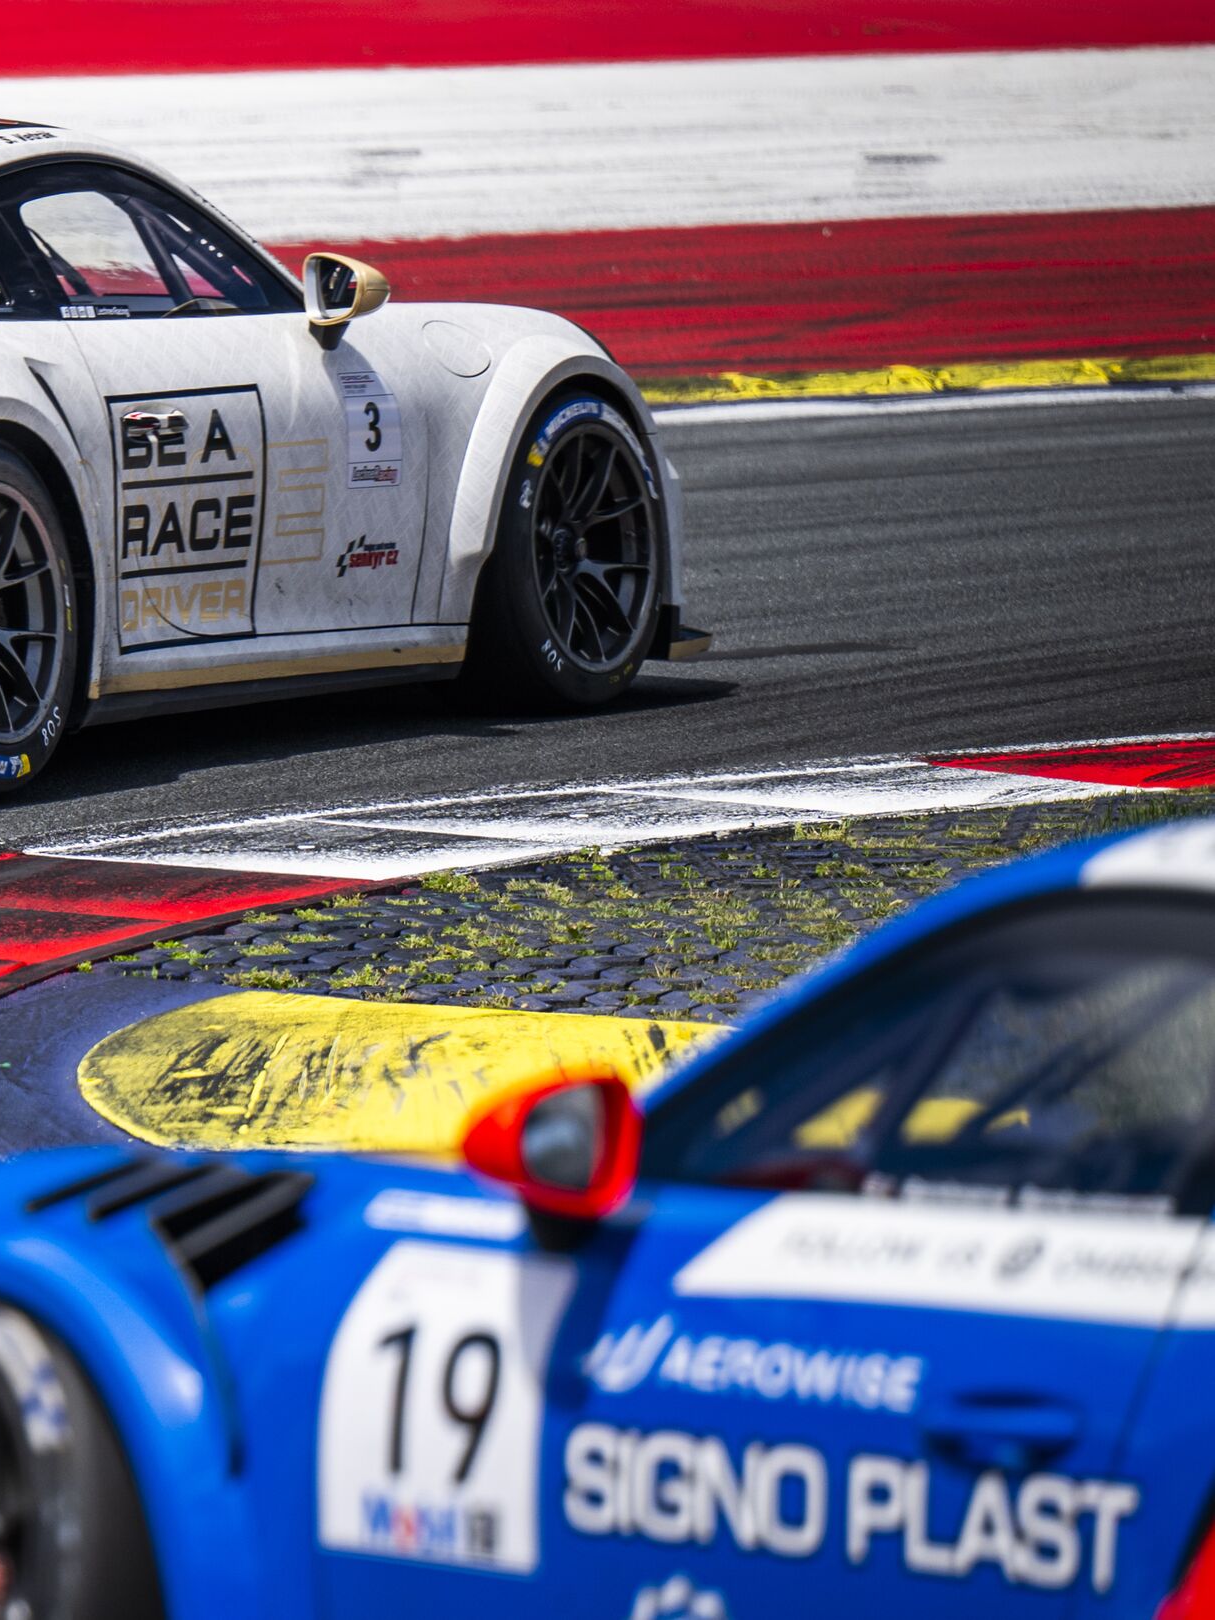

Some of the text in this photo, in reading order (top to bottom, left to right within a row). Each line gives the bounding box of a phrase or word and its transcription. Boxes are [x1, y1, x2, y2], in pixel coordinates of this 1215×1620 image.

[200, 408, 236, 464] A
[363, 401, 382, 453] 3
[121, 494, 256, 560] RACE
[121, 578, 247, 632] DRIVER
[375, 1320, 502, 1485] 19
[659, 1333, 925, 1415] AEROWISE
[563, 1422, 1139, 1596] SIGNO PLAST
